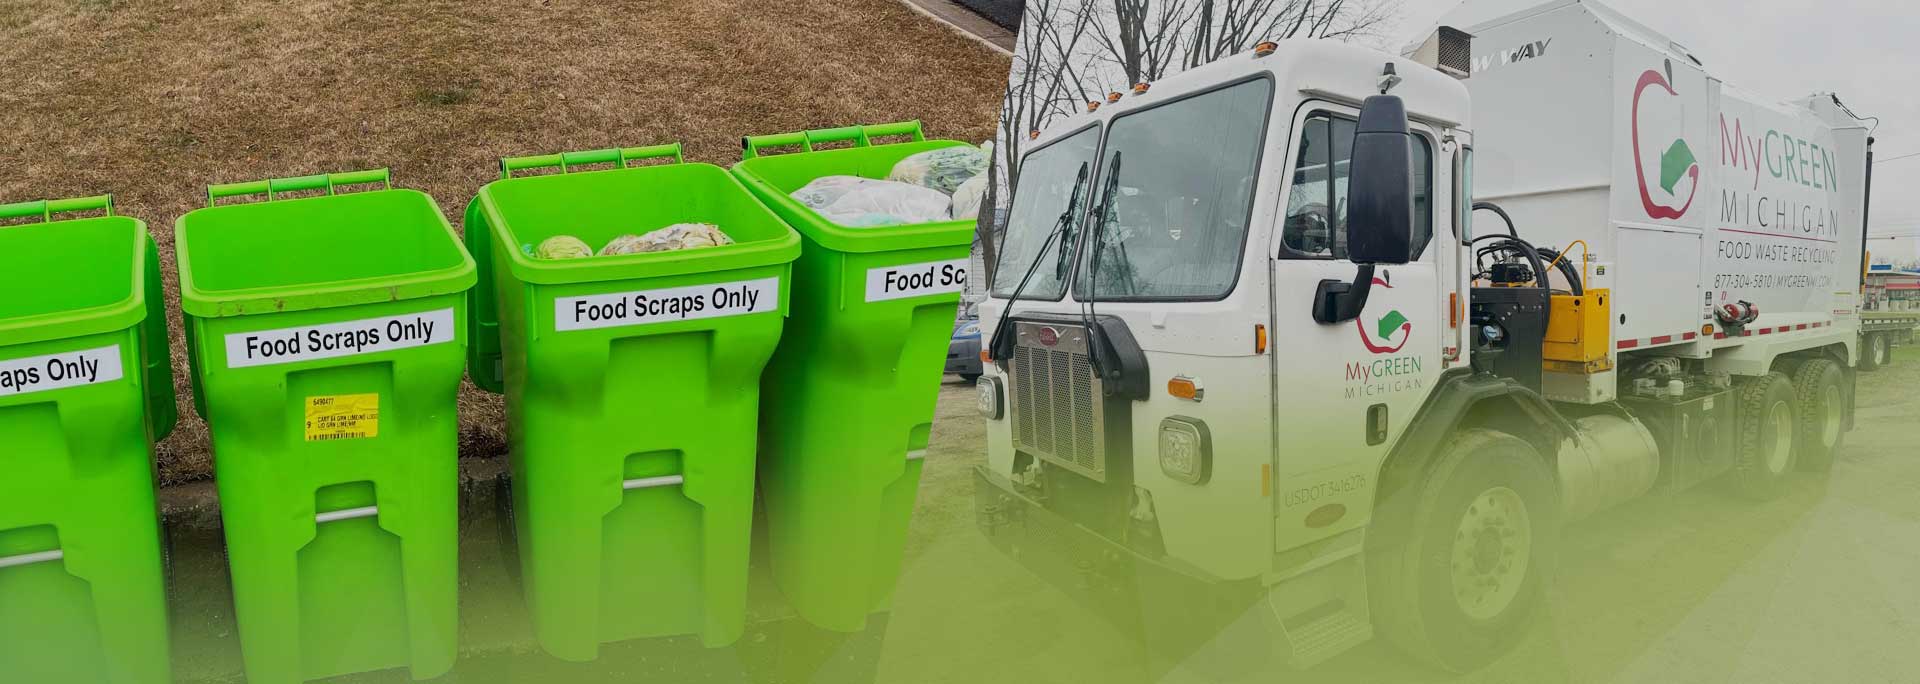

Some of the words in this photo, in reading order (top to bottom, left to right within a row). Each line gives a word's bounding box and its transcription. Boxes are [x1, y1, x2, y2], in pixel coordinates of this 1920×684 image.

[1501, 37, 1552, 66] WAY
[1719, 111, 1838, 193] MyGREEN
[1720, 188, 1839, 238] MICHIGAN
[1718, 240, 1752, 260] FOOD
[1755, 244, 1789, 262] WASTE
[1791, 246, 1837, 264] RECYCLING
[885, 265, 935, 293] Food
[940, 263, 966, 286] Sc
[1714, 274, 1773, 289] 877-304-5810
[575, 296, 627, 323] Food
[633, 294, 705, 318] Scraps
[711, 285, 759, 312] Only
[245, 331, 301, 359] Food
[307, 327, 380, 353] Scraps
[386, 316, 434, 344] Only
[0, 366, 40, 392] aps
[46, 354, 99, 383] Only
[1345, 355, 1422, 385] MyGREEN
[1344, 378, 1422, 399] MICHIGAN
